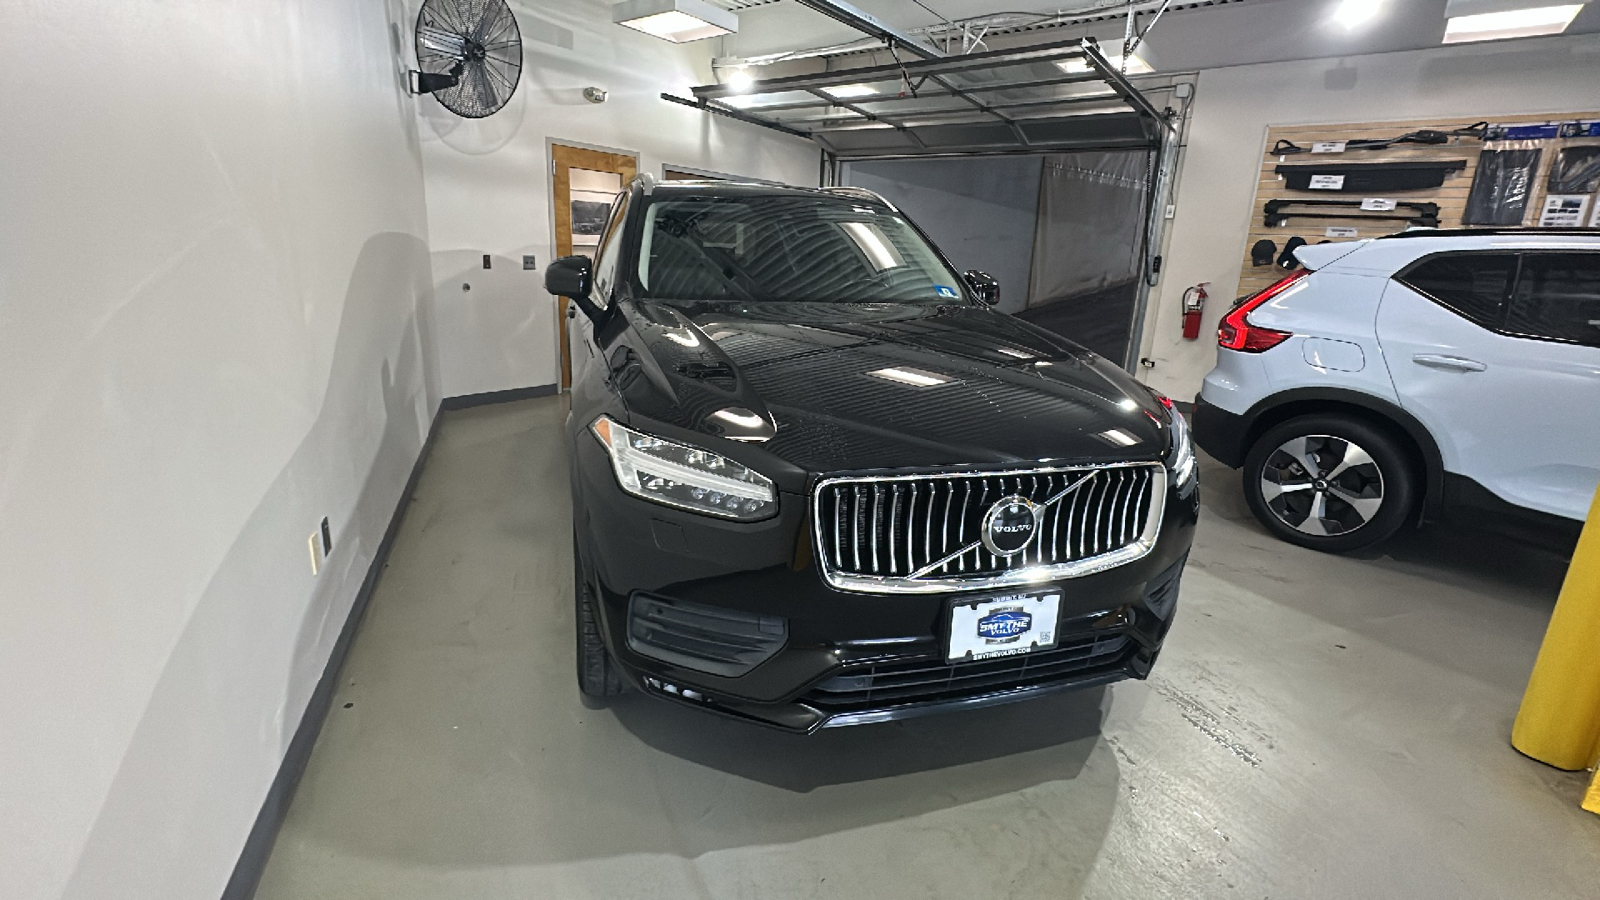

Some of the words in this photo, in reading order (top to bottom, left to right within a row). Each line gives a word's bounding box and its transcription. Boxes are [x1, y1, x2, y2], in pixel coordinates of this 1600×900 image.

[993, 524, 1032, 533] VOLVO
[980, 620, 1028, 632] SMYTHE
[991, 627, 1020, 635] VOLVO
[973, 647, 1031, 660] SMYTHEVOLVO.COM
